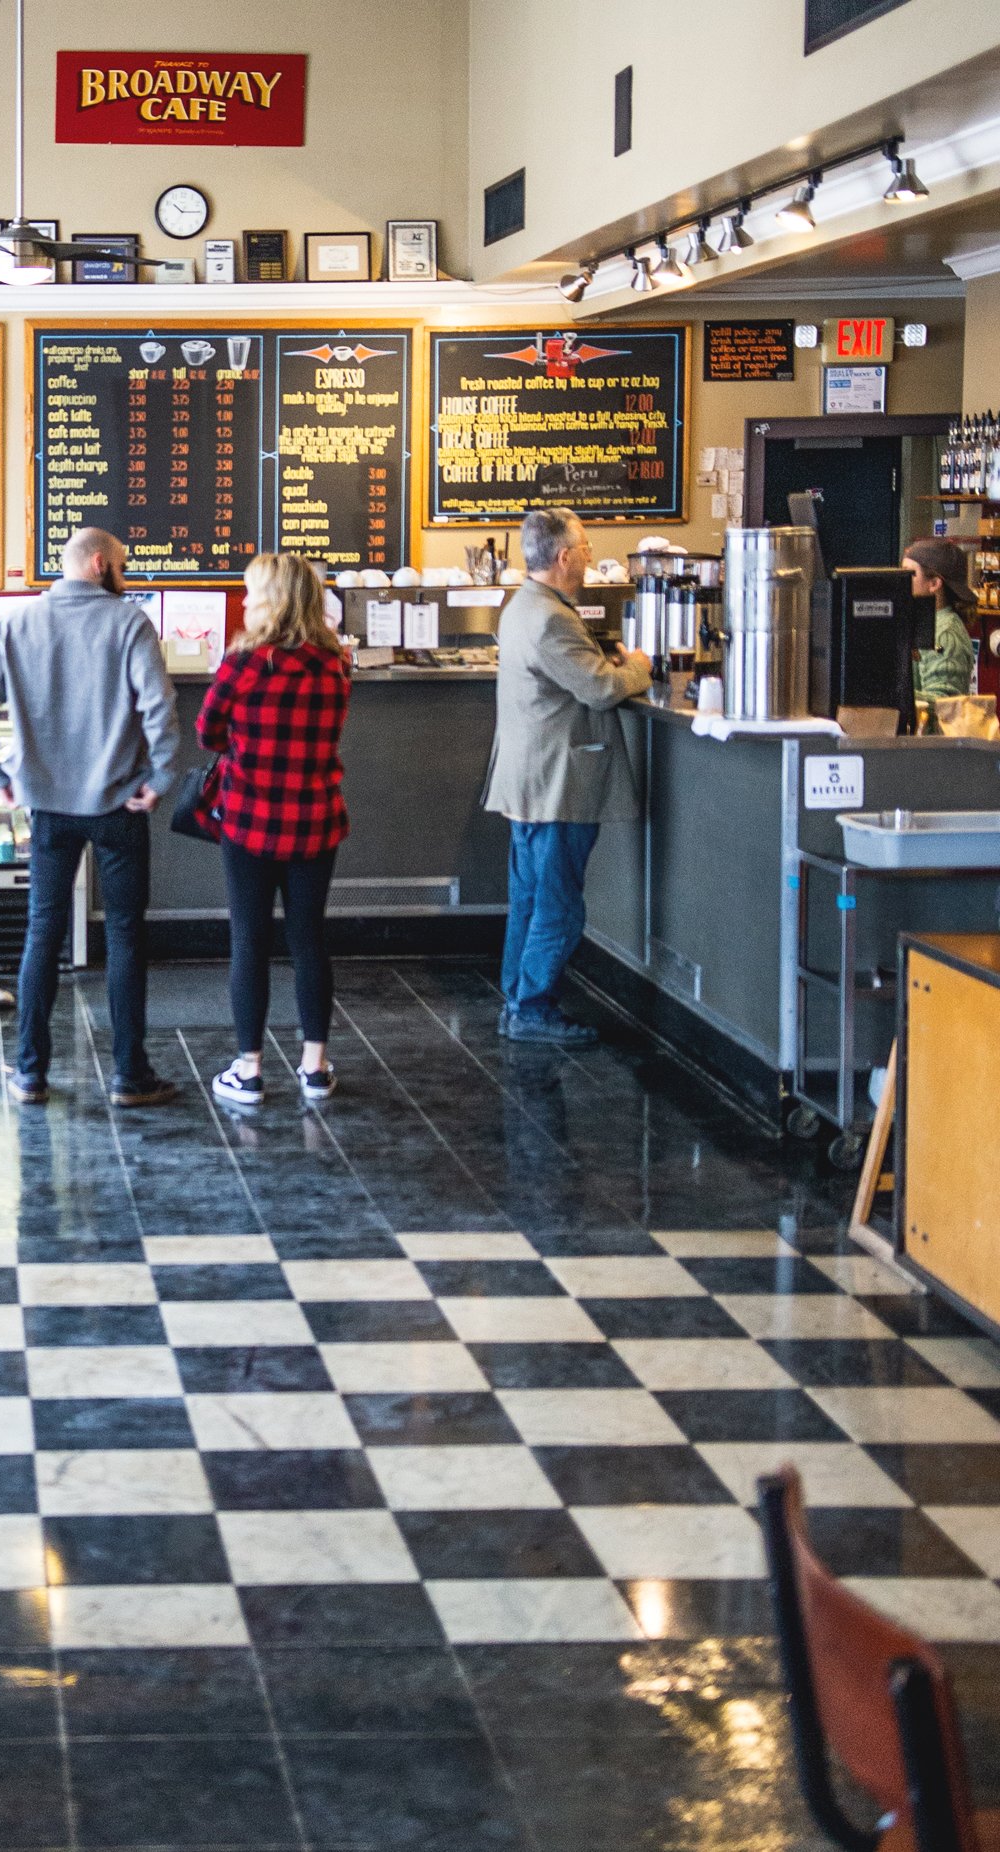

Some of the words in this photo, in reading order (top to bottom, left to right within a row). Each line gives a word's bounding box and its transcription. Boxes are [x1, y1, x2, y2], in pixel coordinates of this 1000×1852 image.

[154, 60, 194, 69] THANKS
[81, 68, 283, 109] BROADWAY
[140, 97, 227, 121] CAFE
[836, 319, 886, 356] EXIT
[74, 363, 89, 372] shot
[128, 367, 149, 380] short
[172, 367, 187, 380] tall
[216, 369, 242, 381] grande
[48, 374, 78, 389] coffee
[315, 368, 365, 389] ESPRESSO
[460, 376, 485, 391] fresh
[486, 375, 522, 390] roasted
[525, 376, 554, 389] coffee
[555, 377, 567, 391] by
[570, 376, 586, 388] the
[588, 377, 604, 391] cup
[607, 378, 619, 388] or
[621, 377, 629, 387] 12
[643, 374, 660, 389] bag
[48, 393, 97, 407] cappuccino
[282, 391, 304, 404] made
[306, 391, 314, 404] to
[343, 391, 353, 404] to
[354, 390, 366, 405] be
[366, 391, 399, 407] enjoyed
[442, 396, 478, 415] HOUSE
[480, 395, 518, 414] COFFEE
[48, 409, 68, 422] cafe
[70, 409, 92, 422] latte
[48, 425, 68, 439] cafe
[69, 425, 100, 439] mocha
[442, 431, 474, 449] DECAF
[476, 431, 509, 449] COFFEE
[48, 442, 68, 456] cafe
[70, 446, 82, 455] au
[84, 442, 102, 455] lait
[606, 445, 635, 454] darker
[637, 444, 657, 454] than
[48, 459, 75, 473] depth
[76, 459, 108, 475] charge
[282, 466, 314, 480] double
[442, 464, 478, 483] COFFEE
[481, 464, 494, 482] OF
[496, 464, 514, 482] THE
[516, 464, 539, 481] DAY
[563, 463, 598, 480] Peru
[48, 476, 87, 489] steamer
[541, 484, 568, 494] Norte
[48, 492, 65, 506] hot
[66, 491, 108, 506] chocolate
[282, 483, 308, 500] quad
[282, 500, 328, 513] macchiato
[48, 509, 64, 522] hot
[66, 509, 82, 522] tea
[48, 525, 68, 539] chai
[282, 519, 300, 530] con
[300, 519, 330, 532] panna
[281, 535, 330, 546] americano
[134, 542, 173, 555] coconut
[211, 542, 230, 555] oat
[163, 558, 200, 571] chocolate
[322, 552, 360, 564] espresso
